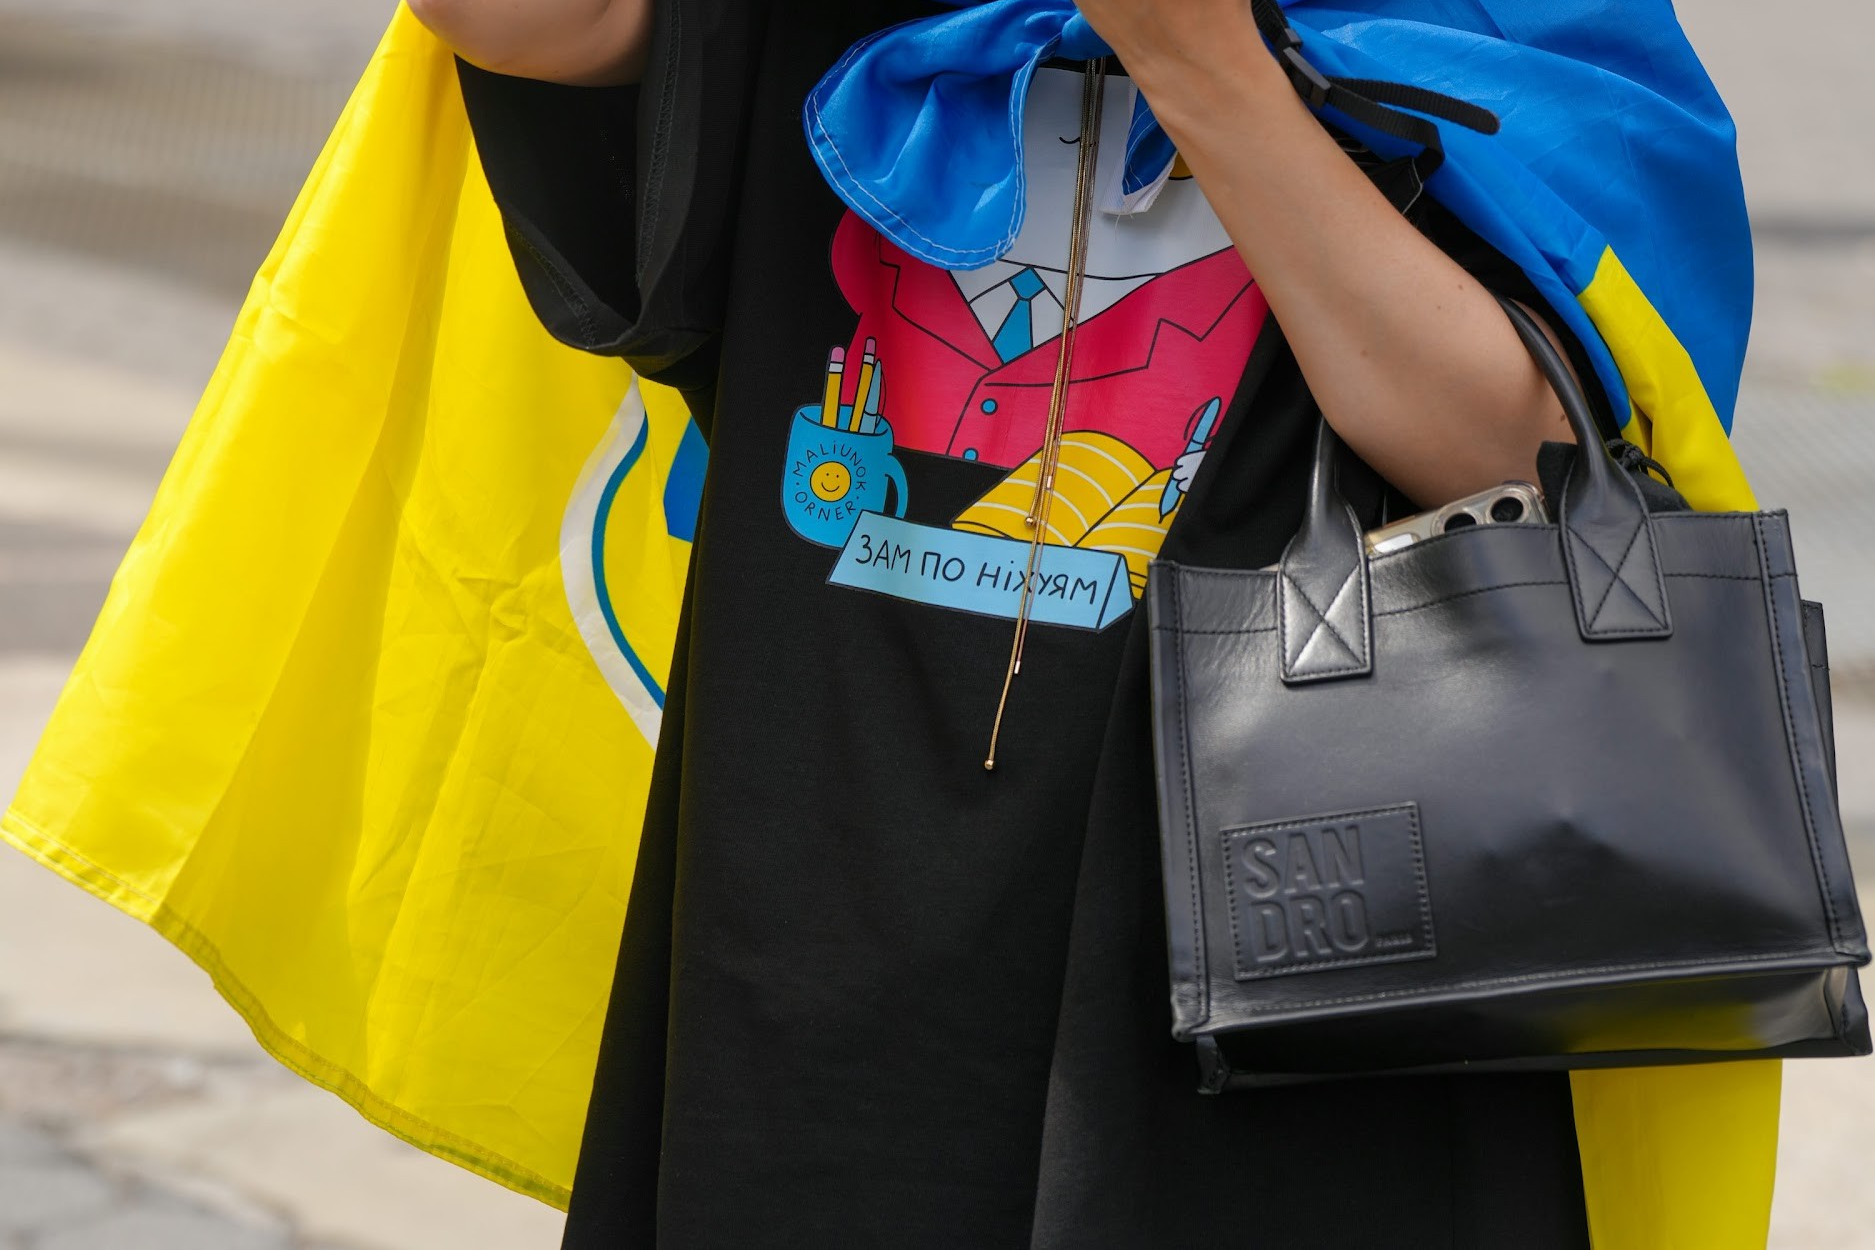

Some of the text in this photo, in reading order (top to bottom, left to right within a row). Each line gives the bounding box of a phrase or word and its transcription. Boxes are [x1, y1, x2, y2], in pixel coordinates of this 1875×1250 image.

[855, 534, 911, 574] ЗАМ
[920, 552, 965, 582] ПО
[1242, 825, 1364, 898] SAN
[1251, 890, 1369, 962] DRO
